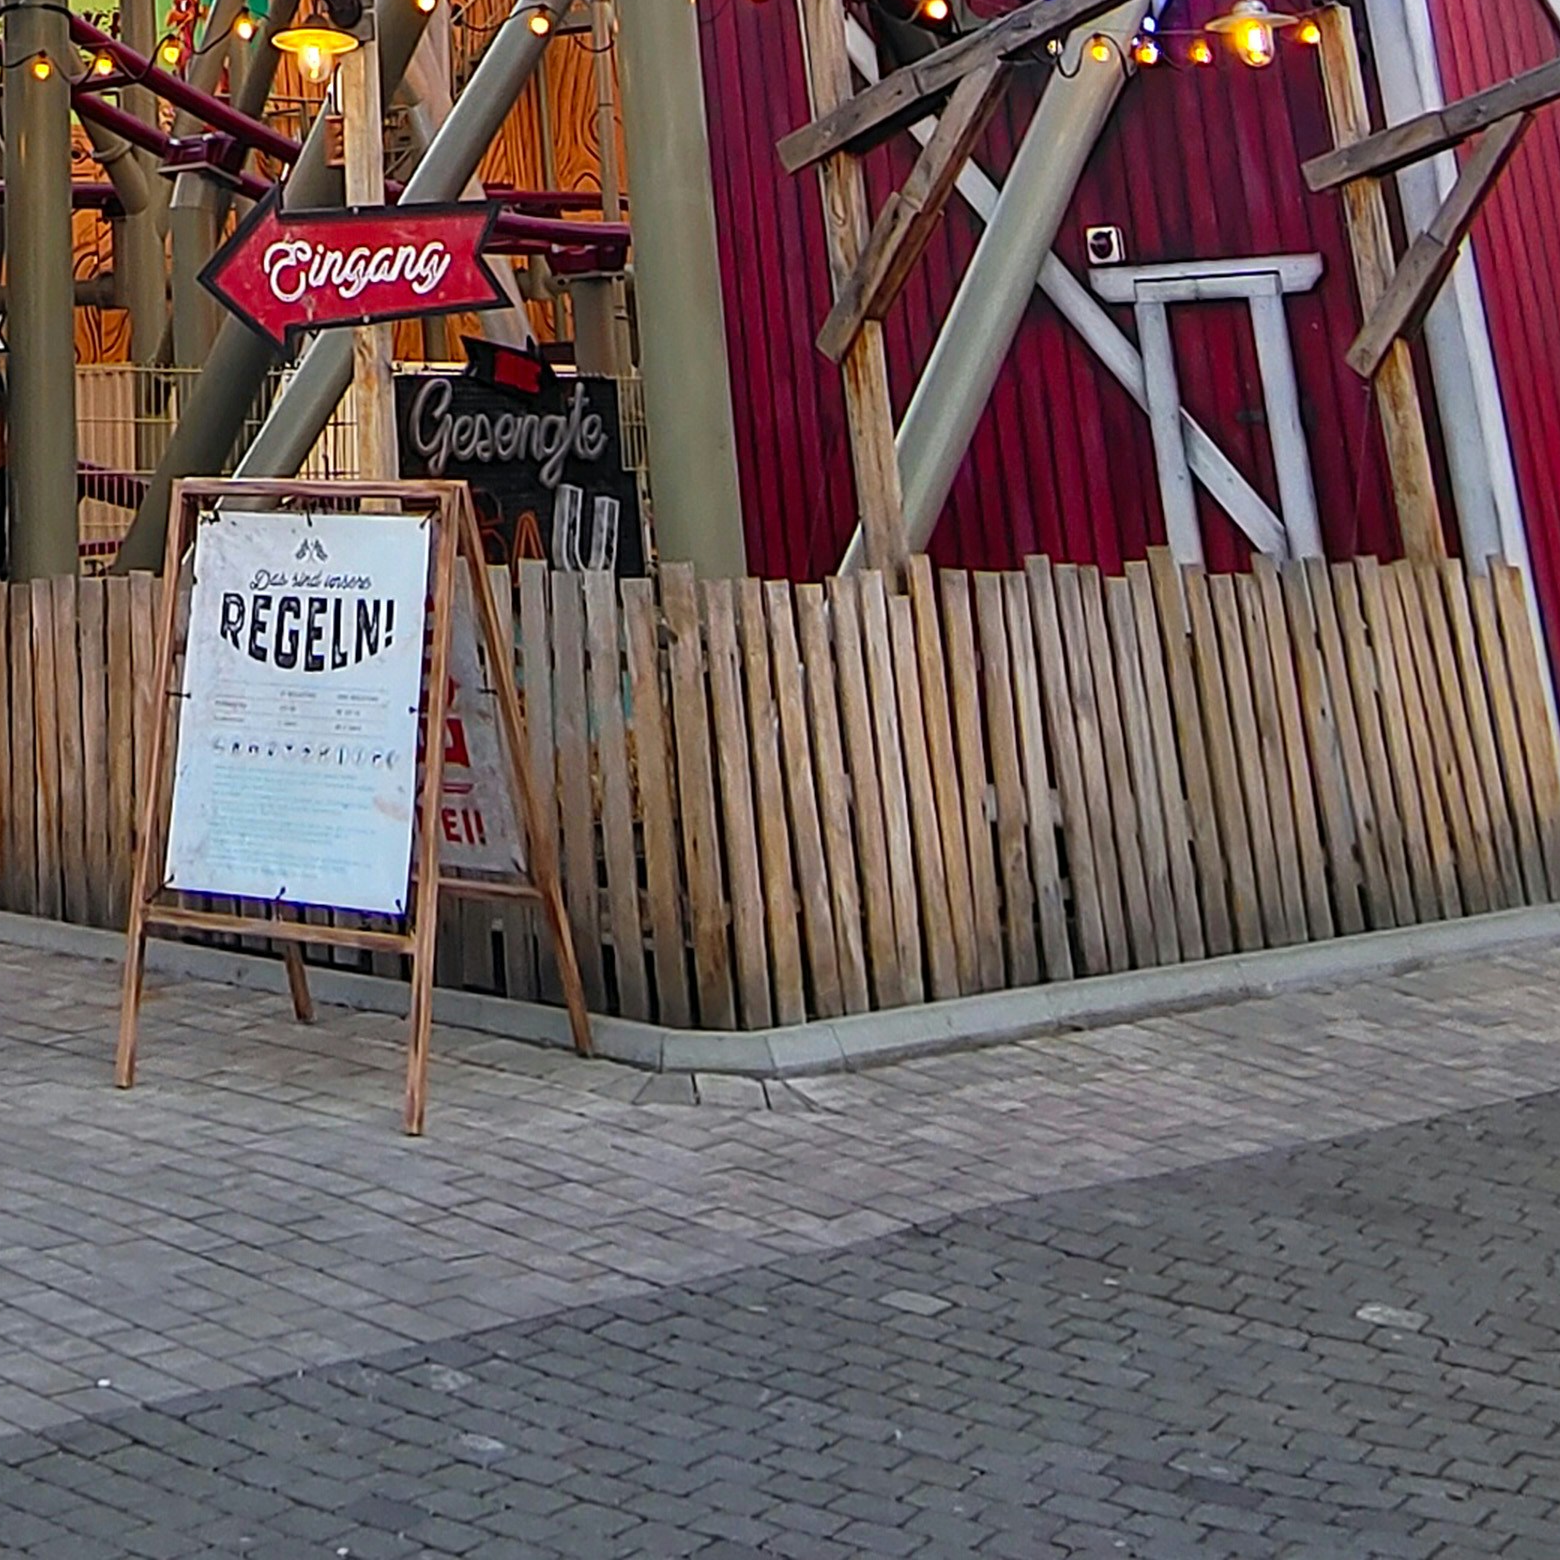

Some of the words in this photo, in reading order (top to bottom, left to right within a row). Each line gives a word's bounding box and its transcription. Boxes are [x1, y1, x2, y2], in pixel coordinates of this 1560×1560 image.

[263, 239, 451, 301] Eingang
[409, 378, 609, 489] Gesengte
[220, 593, 395, 672] REGELN!
